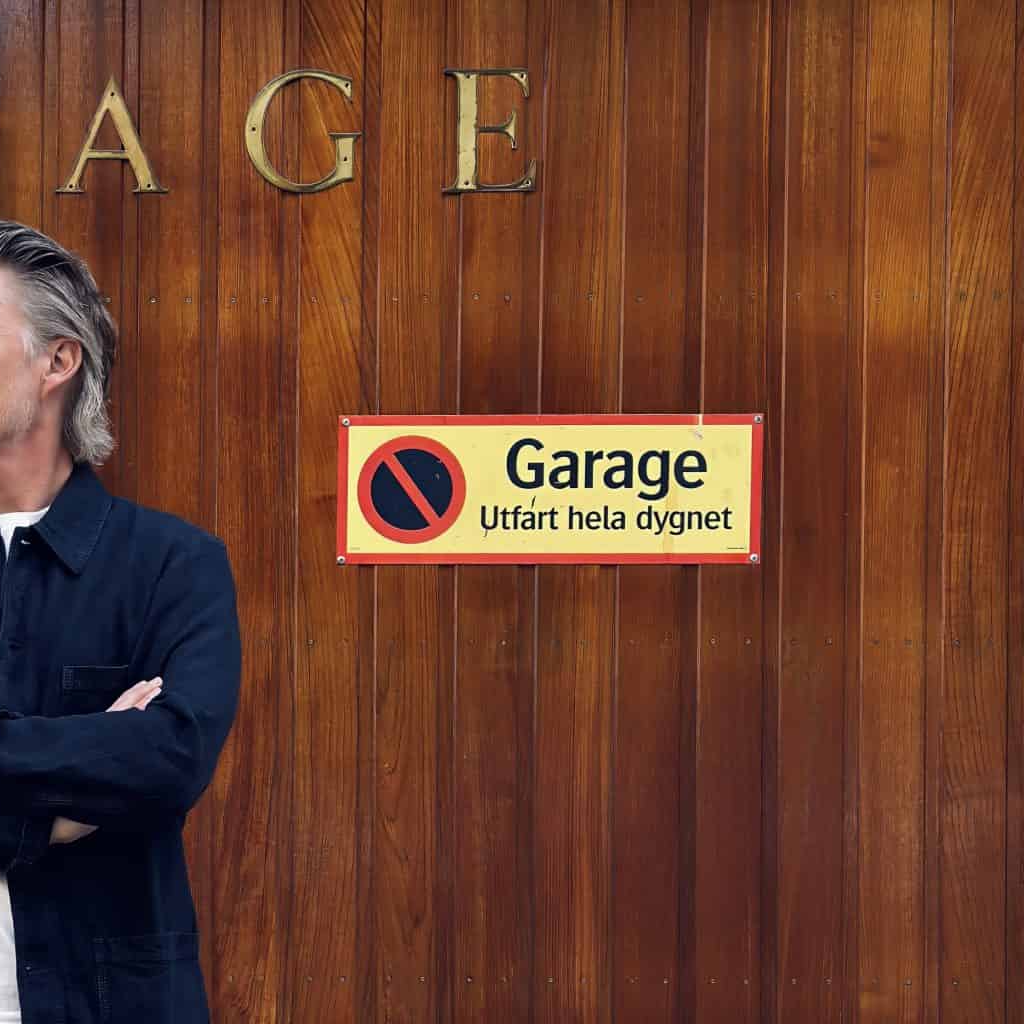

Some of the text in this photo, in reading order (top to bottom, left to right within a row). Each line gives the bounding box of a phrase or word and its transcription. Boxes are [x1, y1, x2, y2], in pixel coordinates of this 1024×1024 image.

[505, 437, 708, 501] Garage
[568, 505, 626, 530] hela
[636, 505, 733, 536] dygnet
